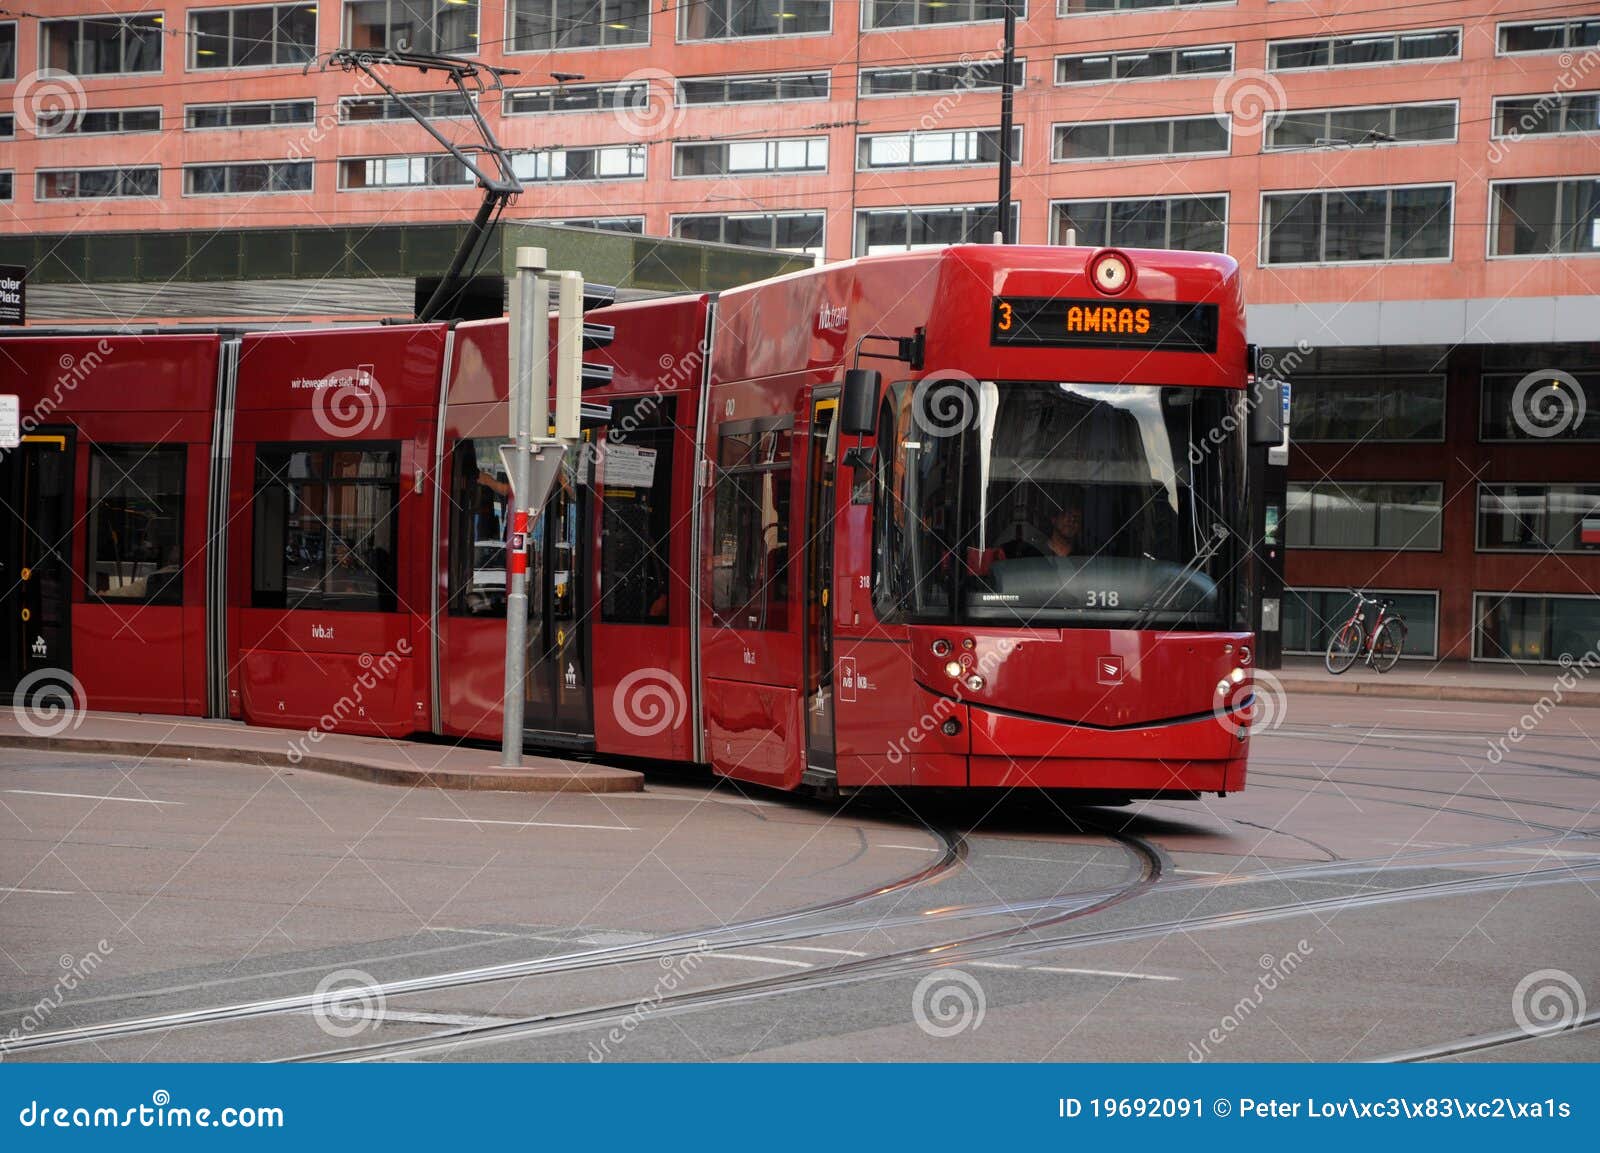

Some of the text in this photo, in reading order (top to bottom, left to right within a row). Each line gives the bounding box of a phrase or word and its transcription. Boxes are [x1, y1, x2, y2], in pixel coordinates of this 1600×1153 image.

[0, 277, 21, 290] oler
[999, 302, 1150, 334] 3 AMRAS
[859, 575, 870, 589] 318
[1086, 590, 1120, 607] 318
[311, 623, 334, 639] ivb.at
